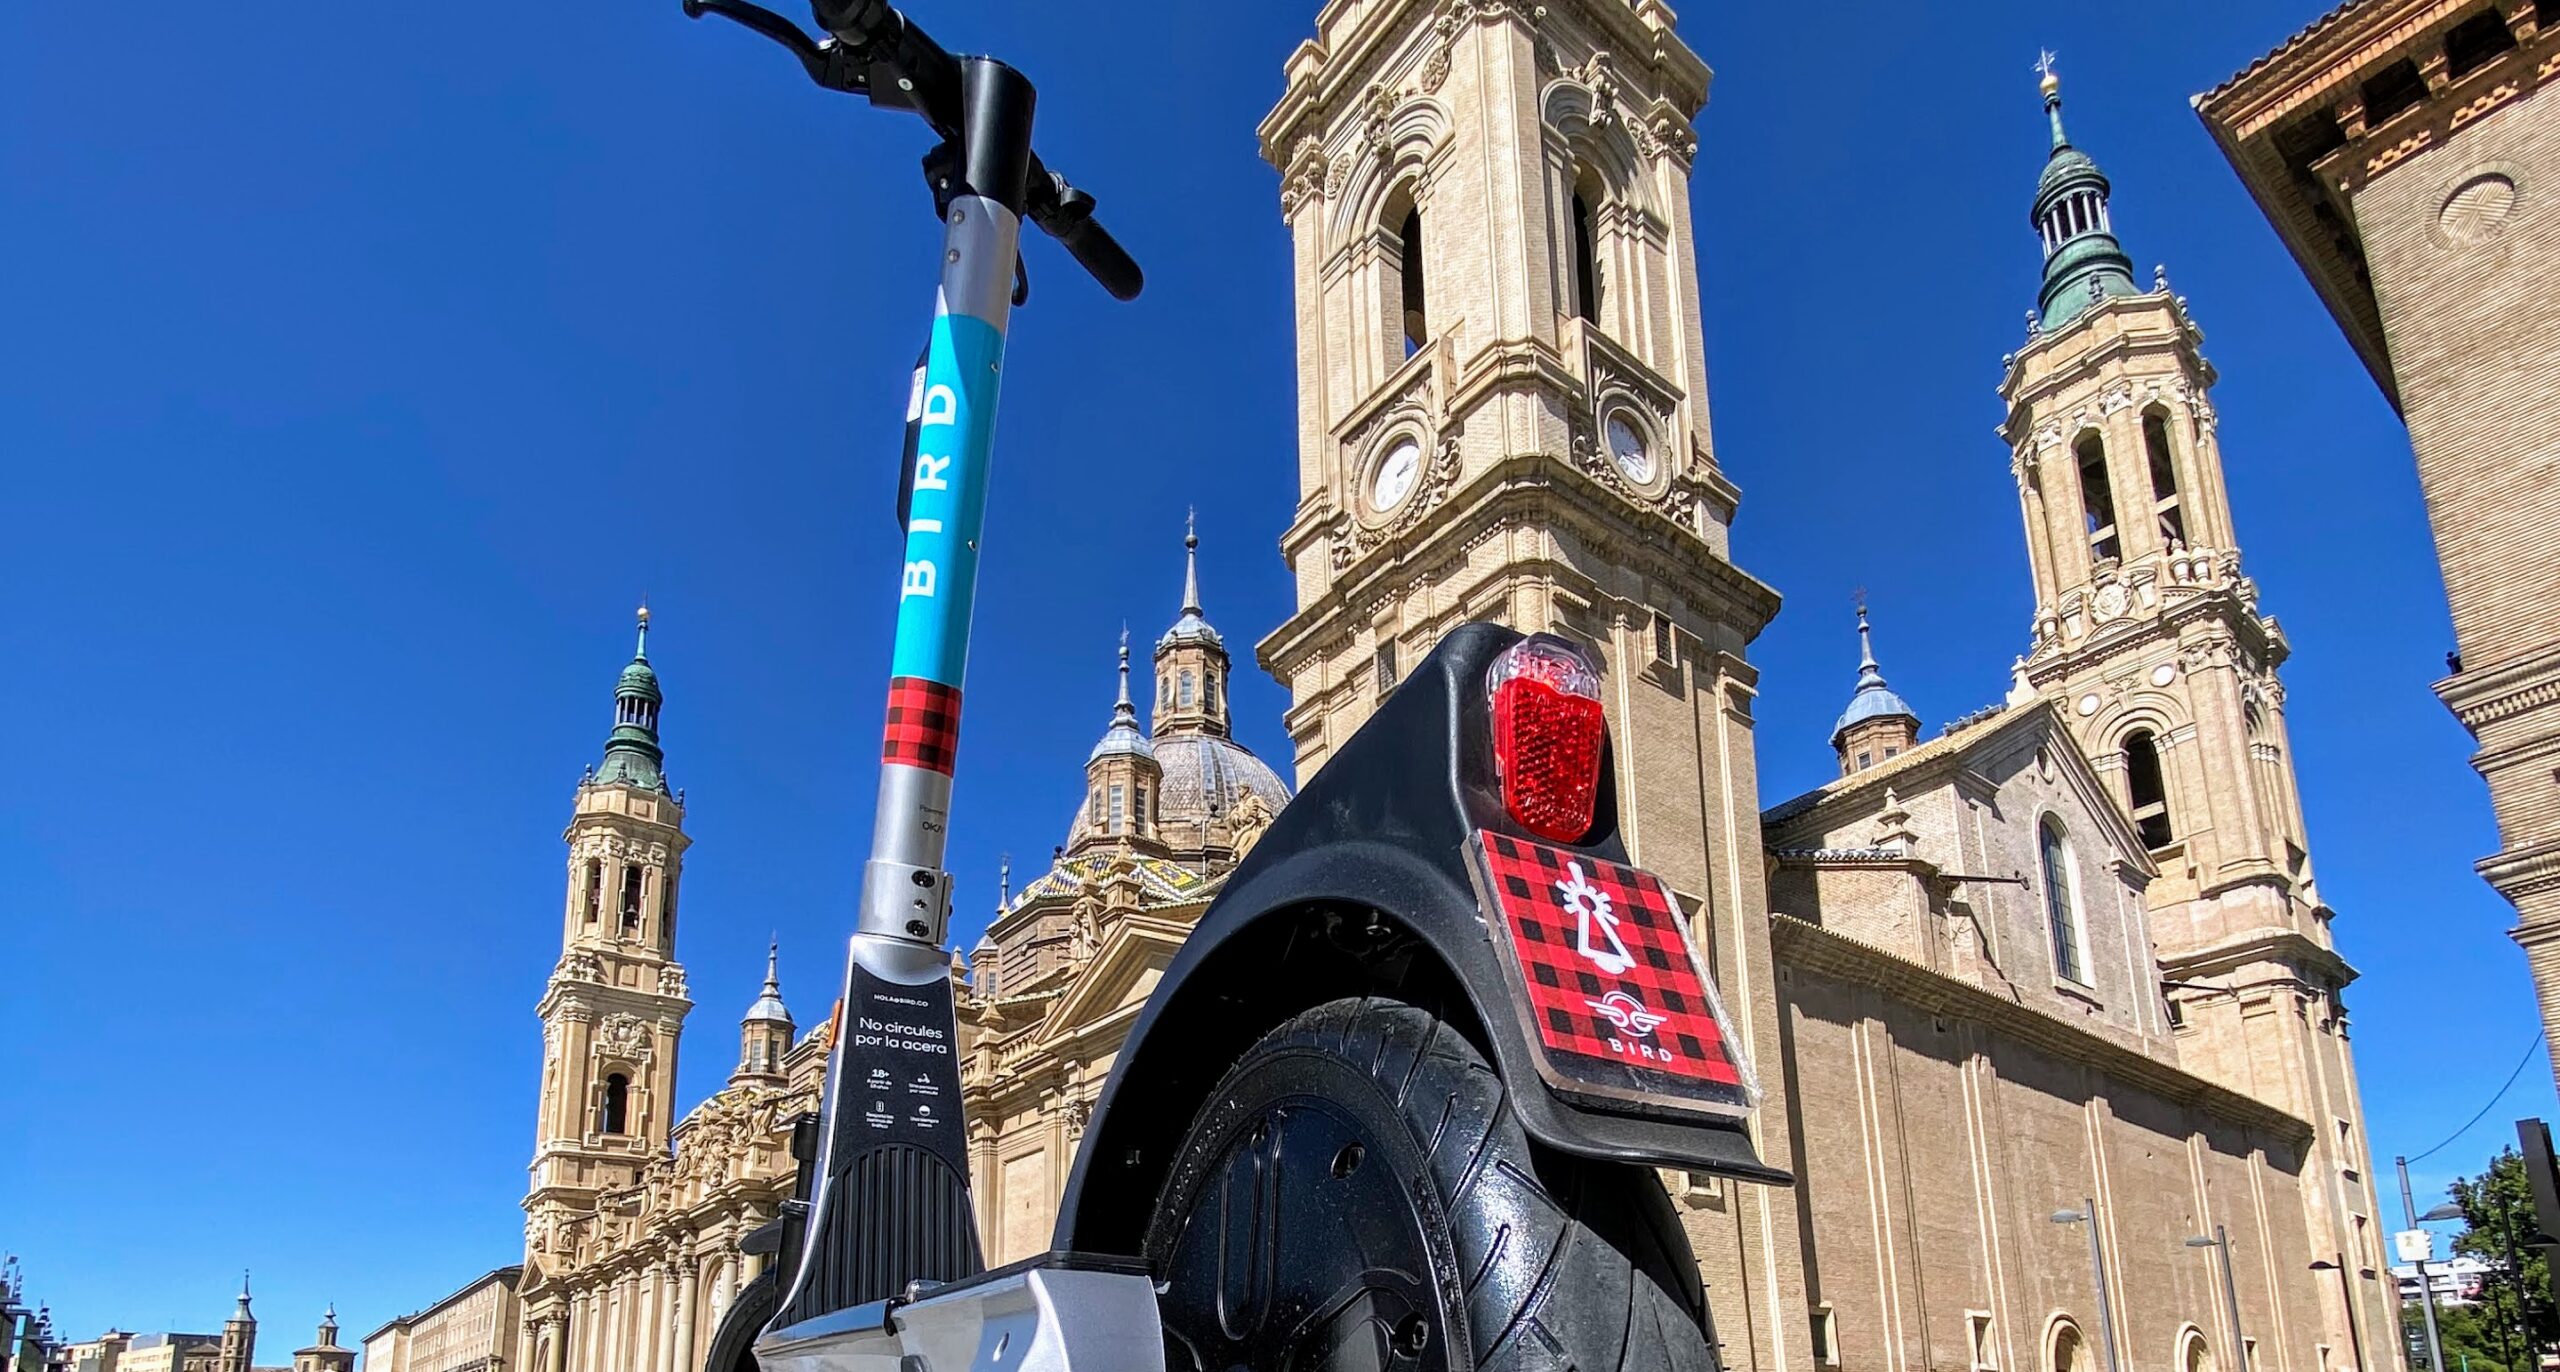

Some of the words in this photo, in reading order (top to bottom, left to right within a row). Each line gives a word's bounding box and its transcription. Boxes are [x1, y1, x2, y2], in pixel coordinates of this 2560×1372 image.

[901, 383, 957, 602] BIRD
[873, 994, 929, 1007] HOLA@BIRD.CO
[860, 1017, 882, 1031] No
[885, 1022, 943, 1039] circules
[855, 1034, 882, 1047] por
[885, 1035, 899, 1048] la
[902, 1041, 947, 1054] acera
[1608, 1037, 1673, 1062] BIRD
[871, 1068, 890, 1078] 18+
